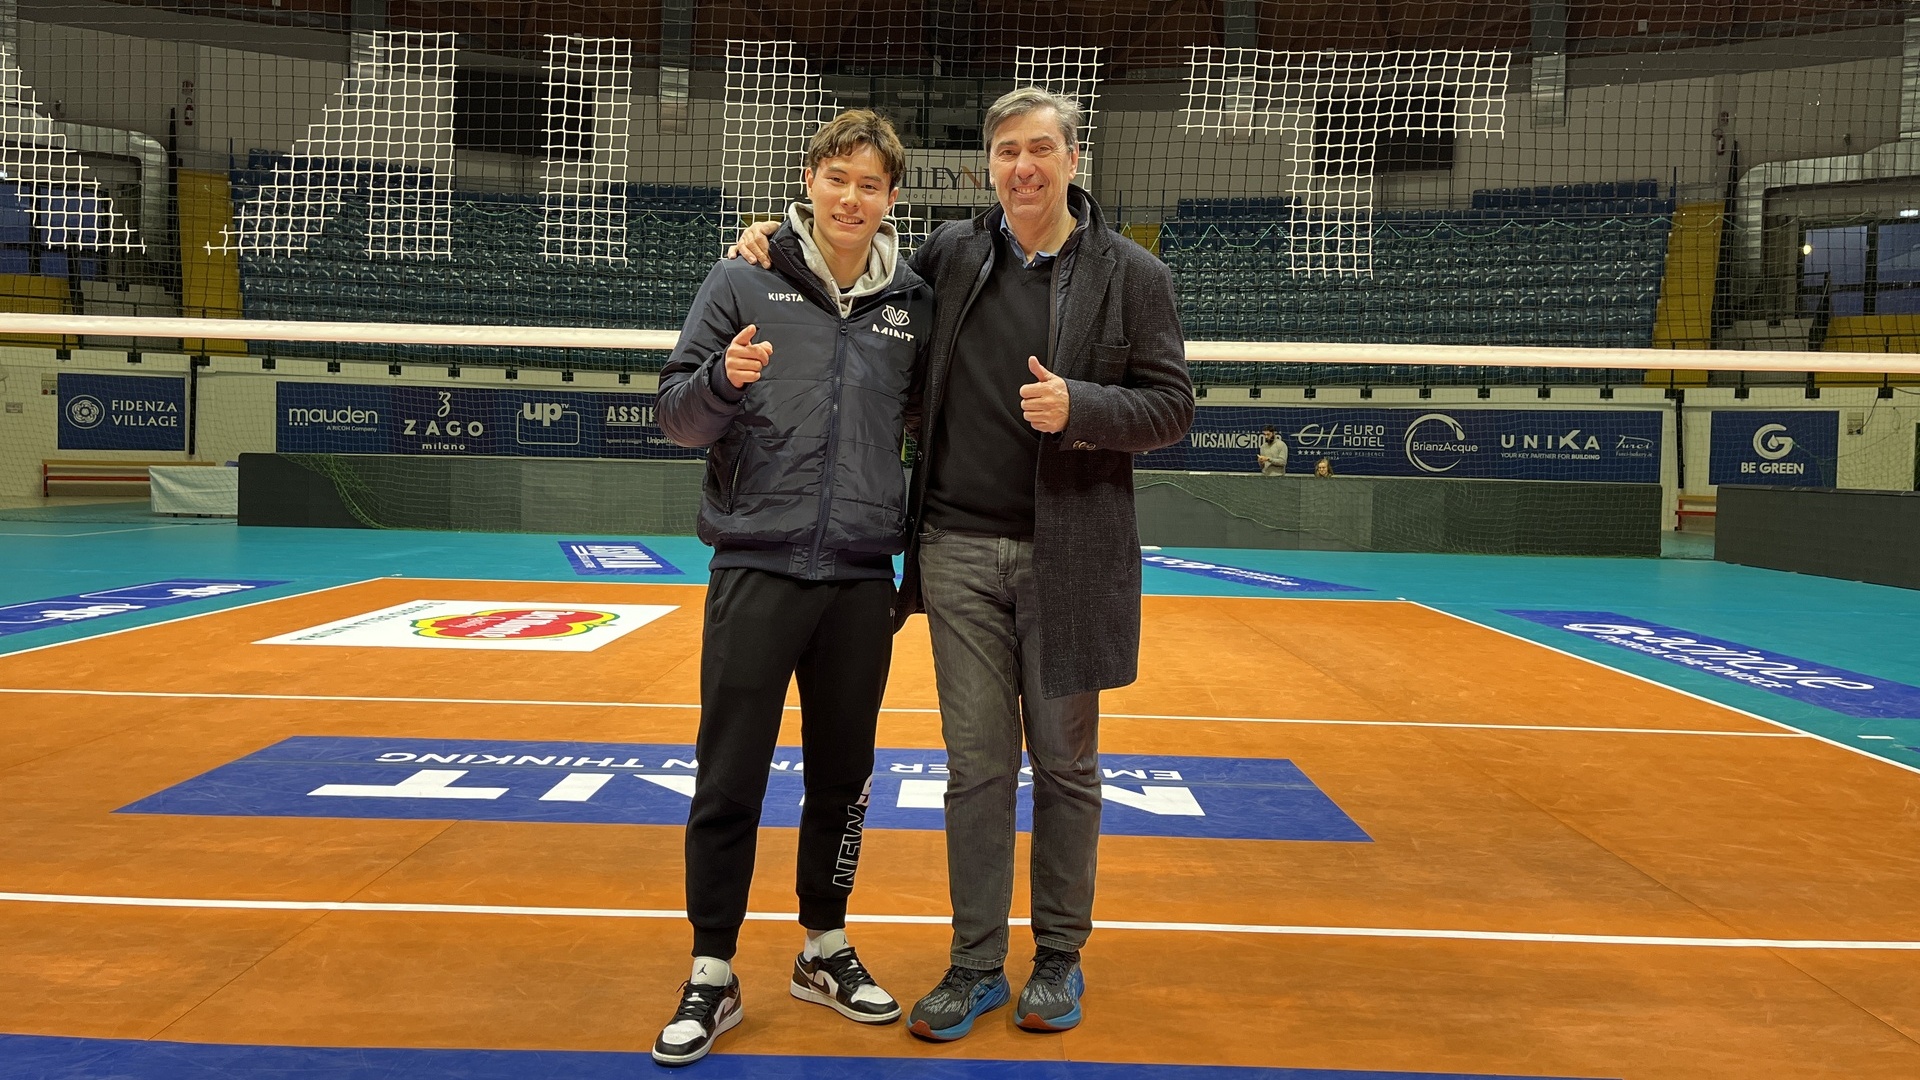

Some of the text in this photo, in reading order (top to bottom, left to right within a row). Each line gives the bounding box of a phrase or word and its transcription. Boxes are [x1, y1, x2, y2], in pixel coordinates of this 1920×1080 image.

[768, 292, 804, 302] KIPSTA
[872, 324, 915, 342] MINT
[112, 400, 178, 412] FIDENZA
[288, 406, 378, 425] mauden
[523, 402, 563, 427] up
[112, 415, 178, 427] VILLAGE
[351, 425, 378, 433] Company
[403, 419, 484, 437] ZAGO
[1344, 424, 1385, 436] EURO
[1343, 436, 1385, 447] HOTEL
[1501, 429, 1600, 450] UNIKA
[422, 442, 466, 450] milano
[1413, 441, 1478, 453] BrianzAcque
[1741, 462, 1805, 475] BE GREEN
[374, 752, 646, 768] THINKING
